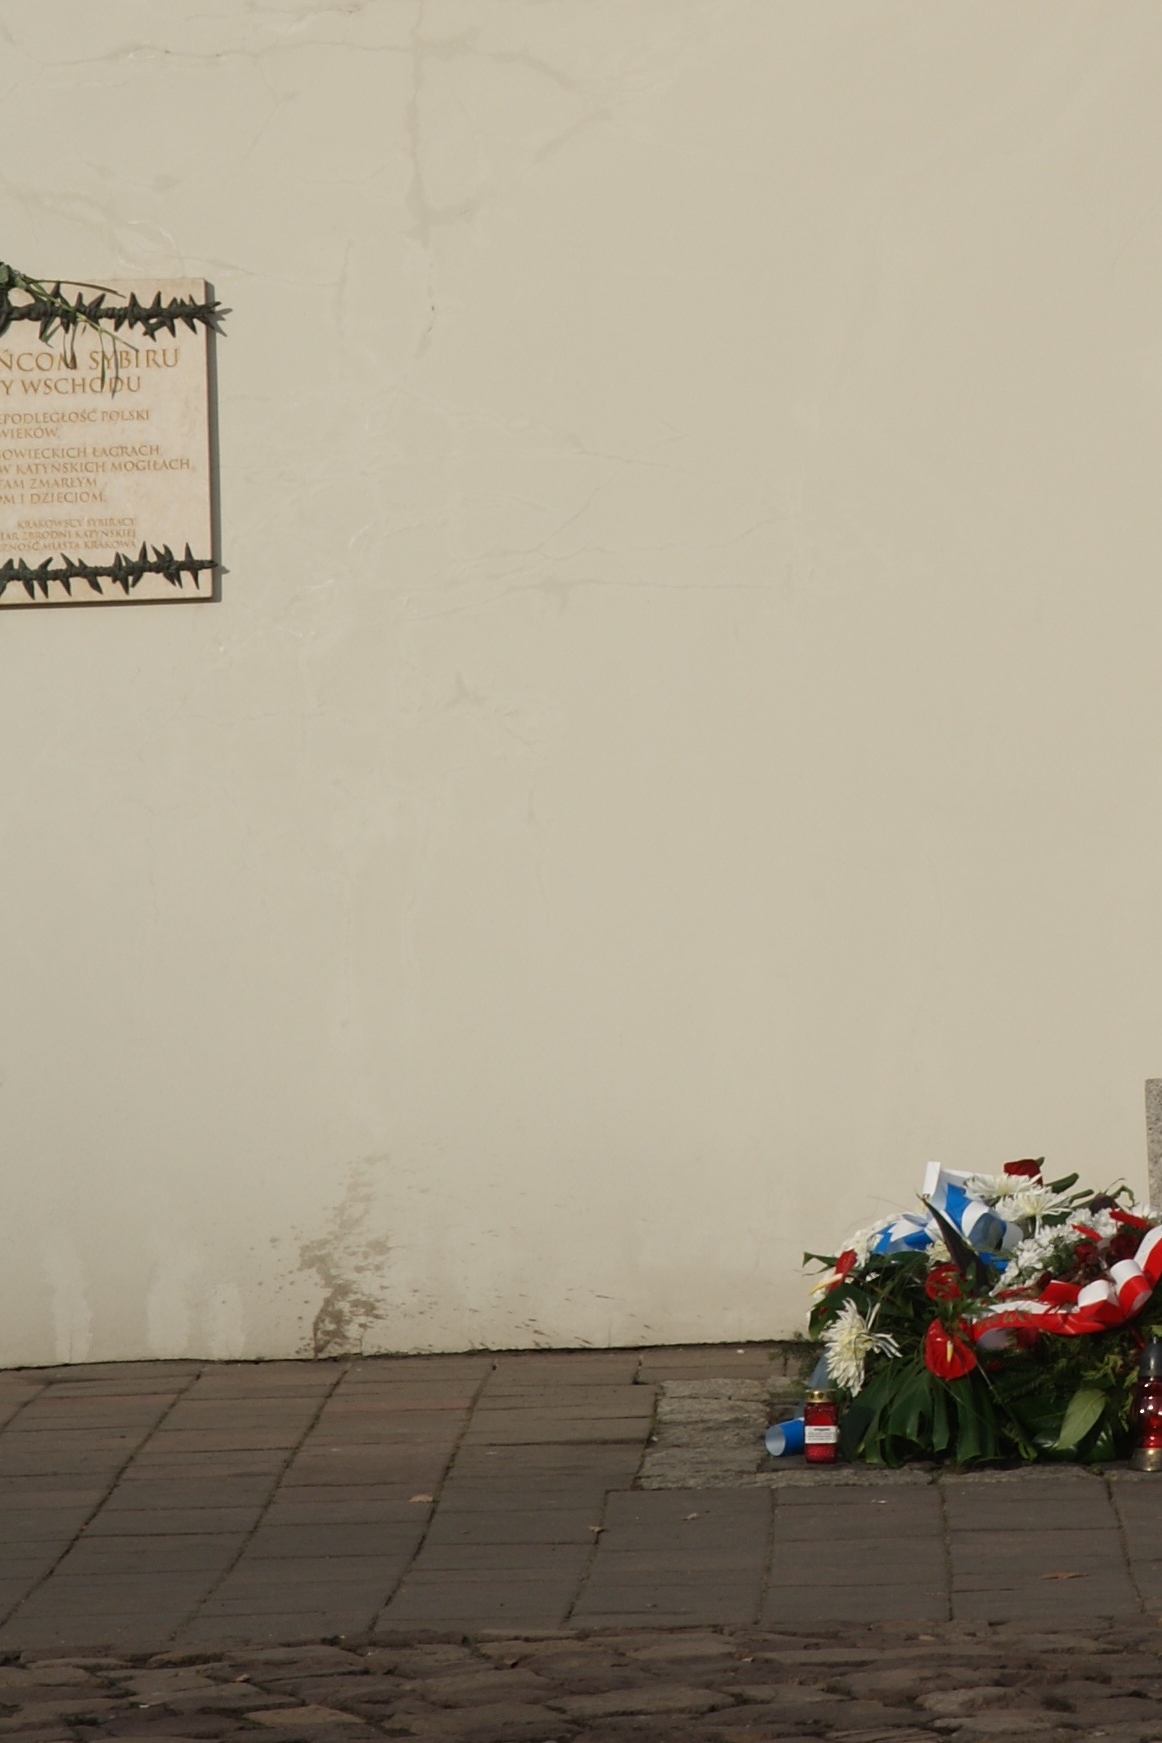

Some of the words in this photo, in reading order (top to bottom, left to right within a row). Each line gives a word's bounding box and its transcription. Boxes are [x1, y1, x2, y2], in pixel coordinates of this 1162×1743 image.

[89, 348, 180, 370] SYBIRU
[21, 376, 142, 395] WSCHODU
[101, 409, 150, 422] POLSKI
[0, 446, 87, 461] OWIECKICH
